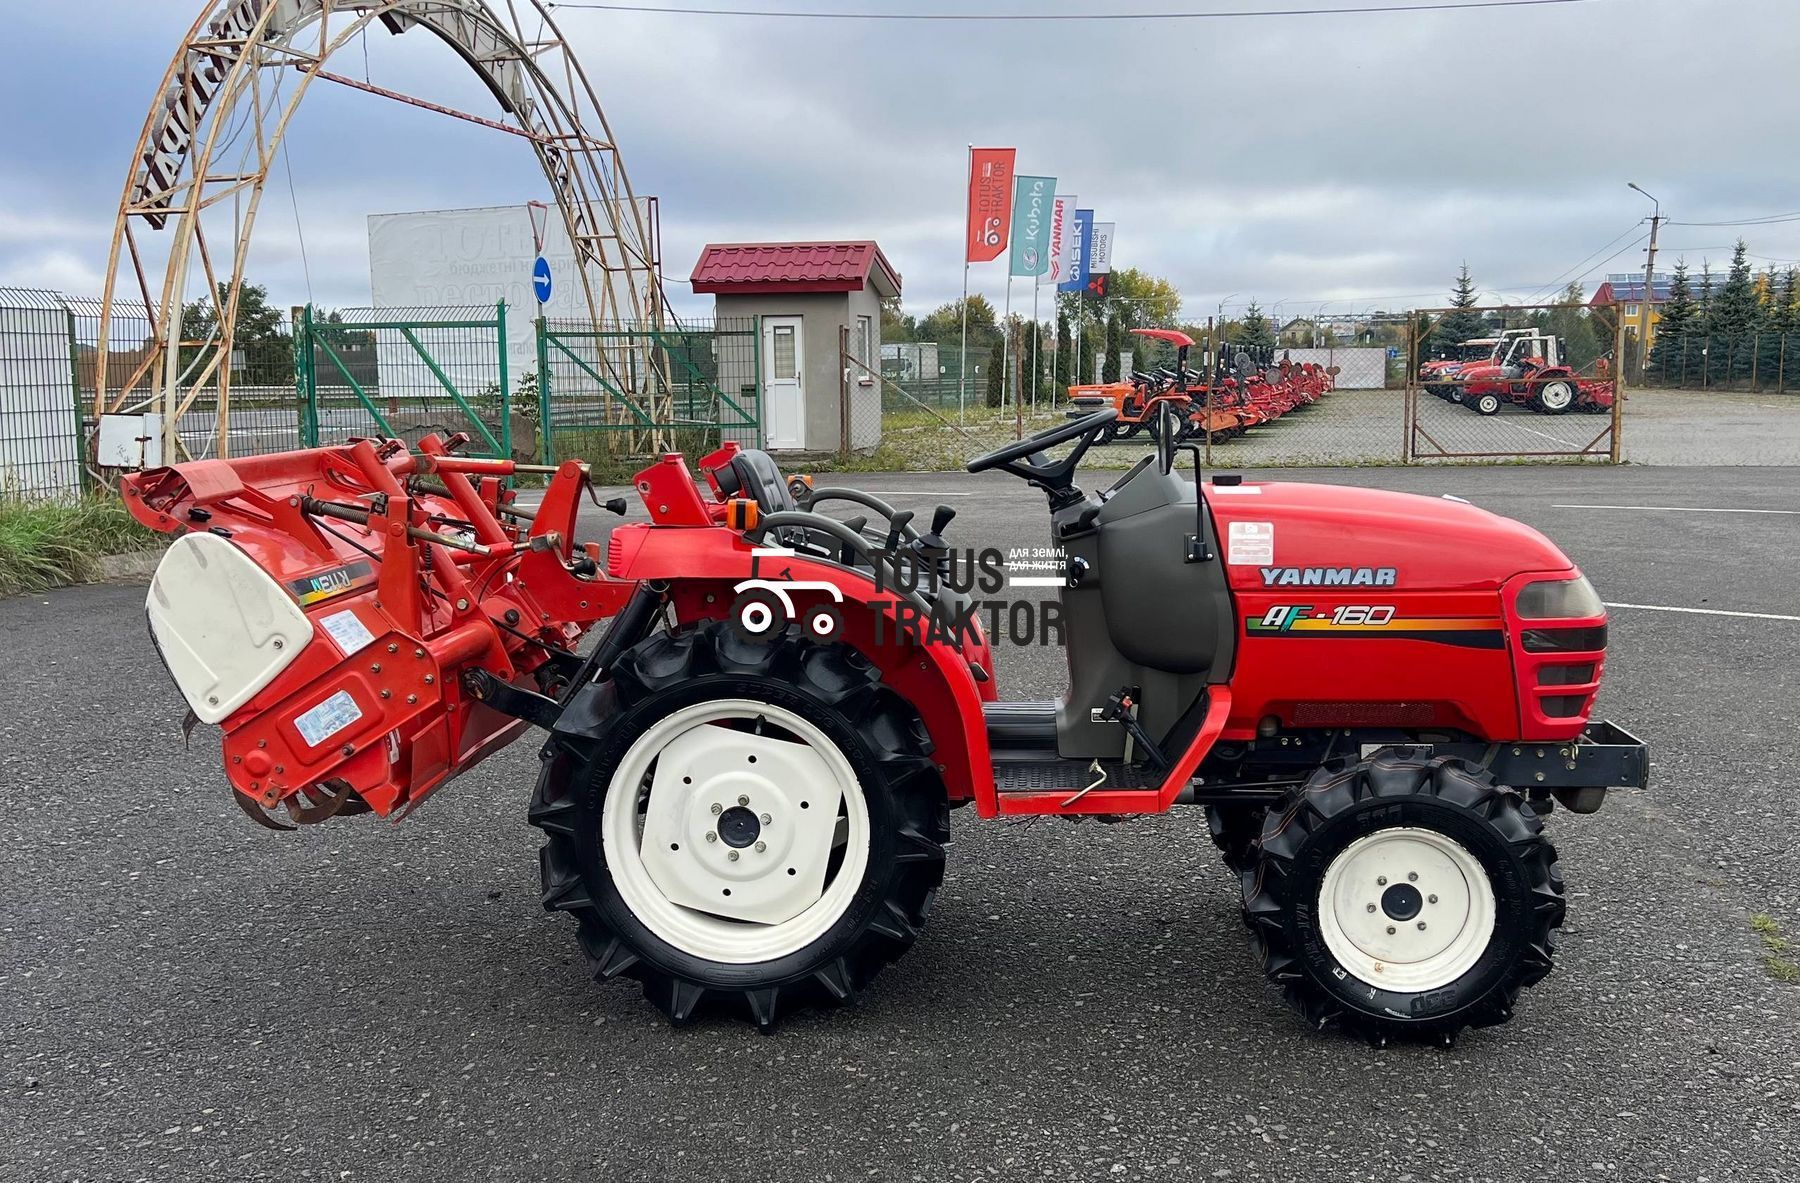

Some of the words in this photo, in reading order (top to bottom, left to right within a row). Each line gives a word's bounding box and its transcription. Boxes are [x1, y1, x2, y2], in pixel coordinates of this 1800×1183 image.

[979, 177, 991, 213] TOTUS
[991, 160, 1005, 216] TRAKTOR
[1025, 181, 1044, 240] Kubota
[1051, 199, 1064, 258] YANMAR
[1090, 228, 1099, 269] MITSUBISHI
[1099, 234, 1107, 263] MOTORS
[1260, 567, 1397, 587] YANMAR
